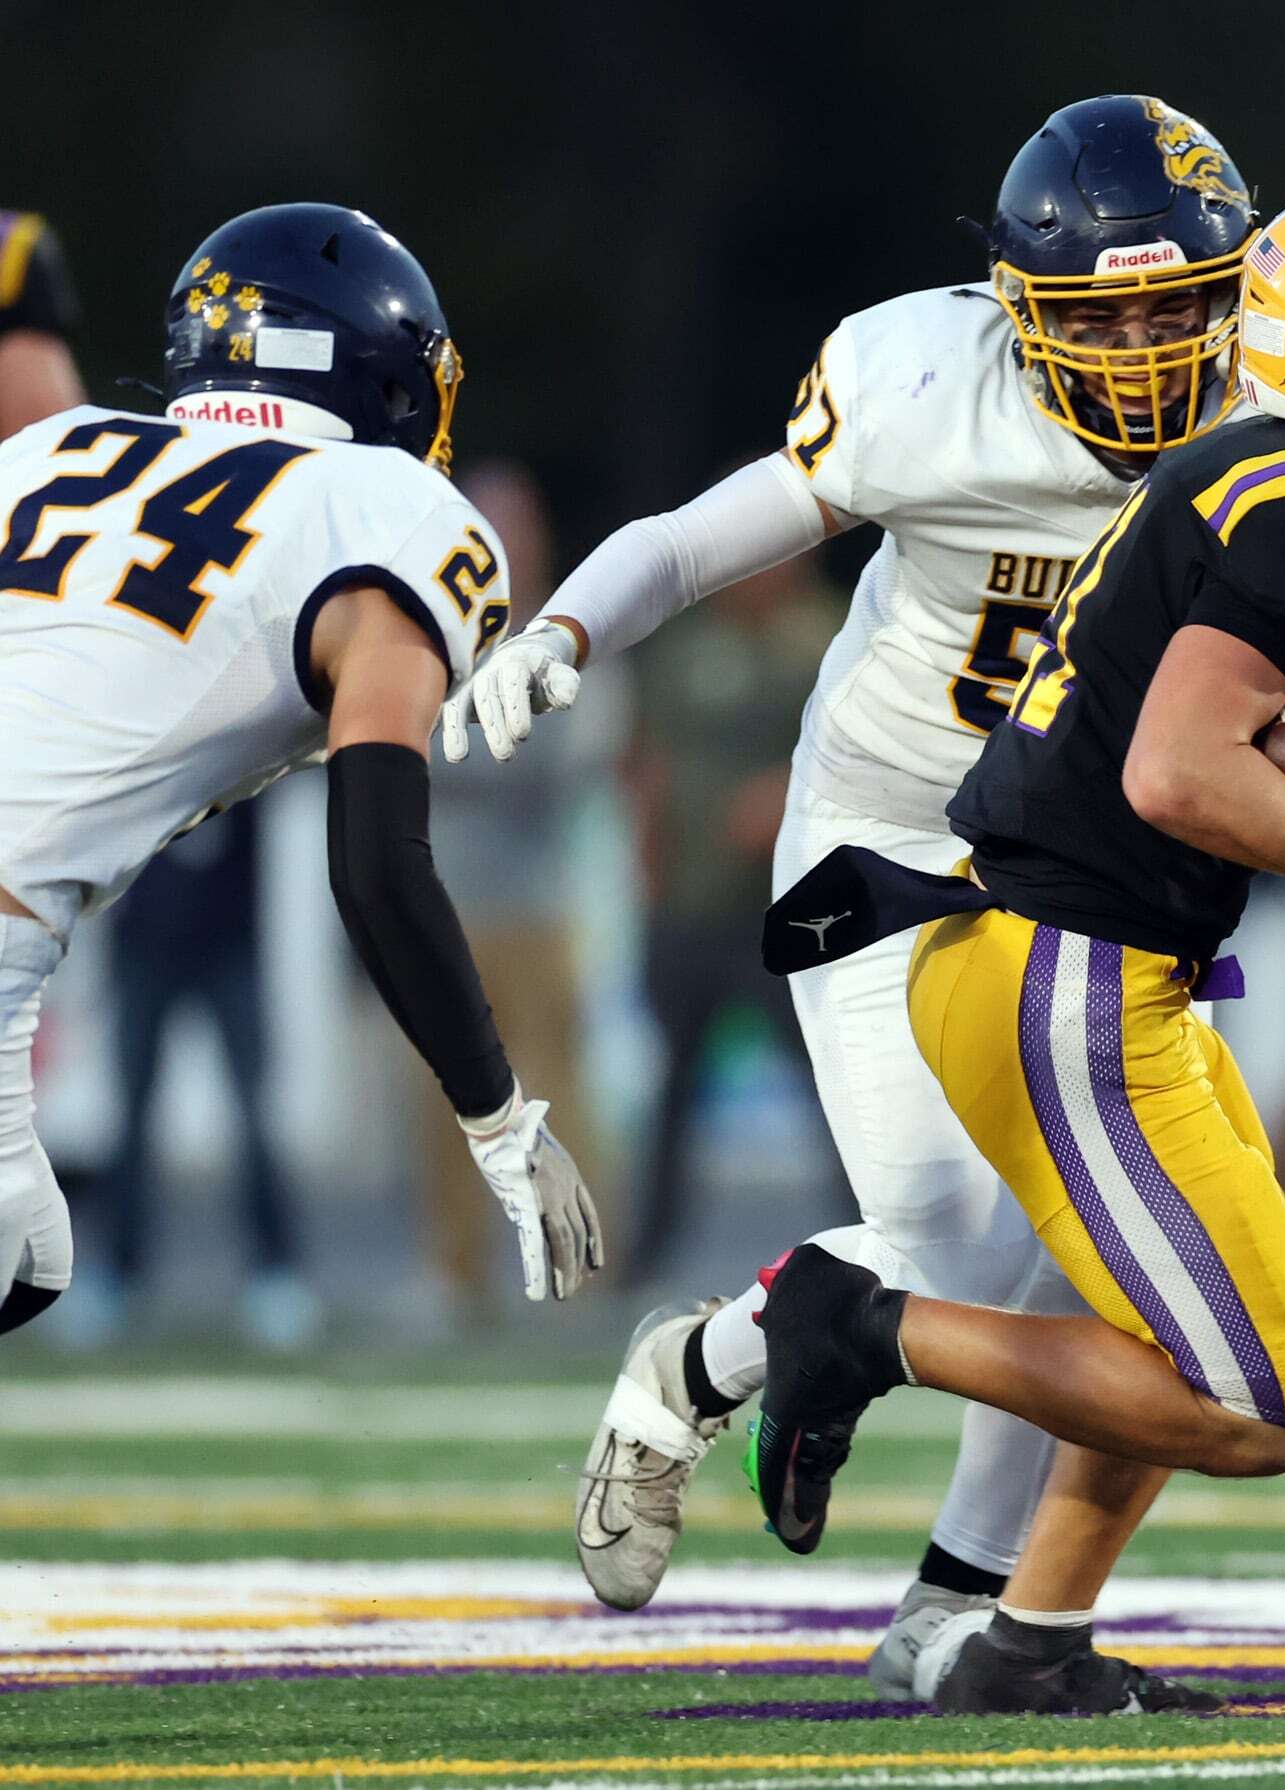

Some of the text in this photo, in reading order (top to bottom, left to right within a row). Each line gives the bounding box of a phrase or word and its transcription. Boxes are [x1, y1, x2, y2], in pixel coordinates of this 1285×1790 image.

[1107, 247, 1174, 269] Riddell
[229, 334, 254, 362] 24
[0, 417, 325, 645] 24
